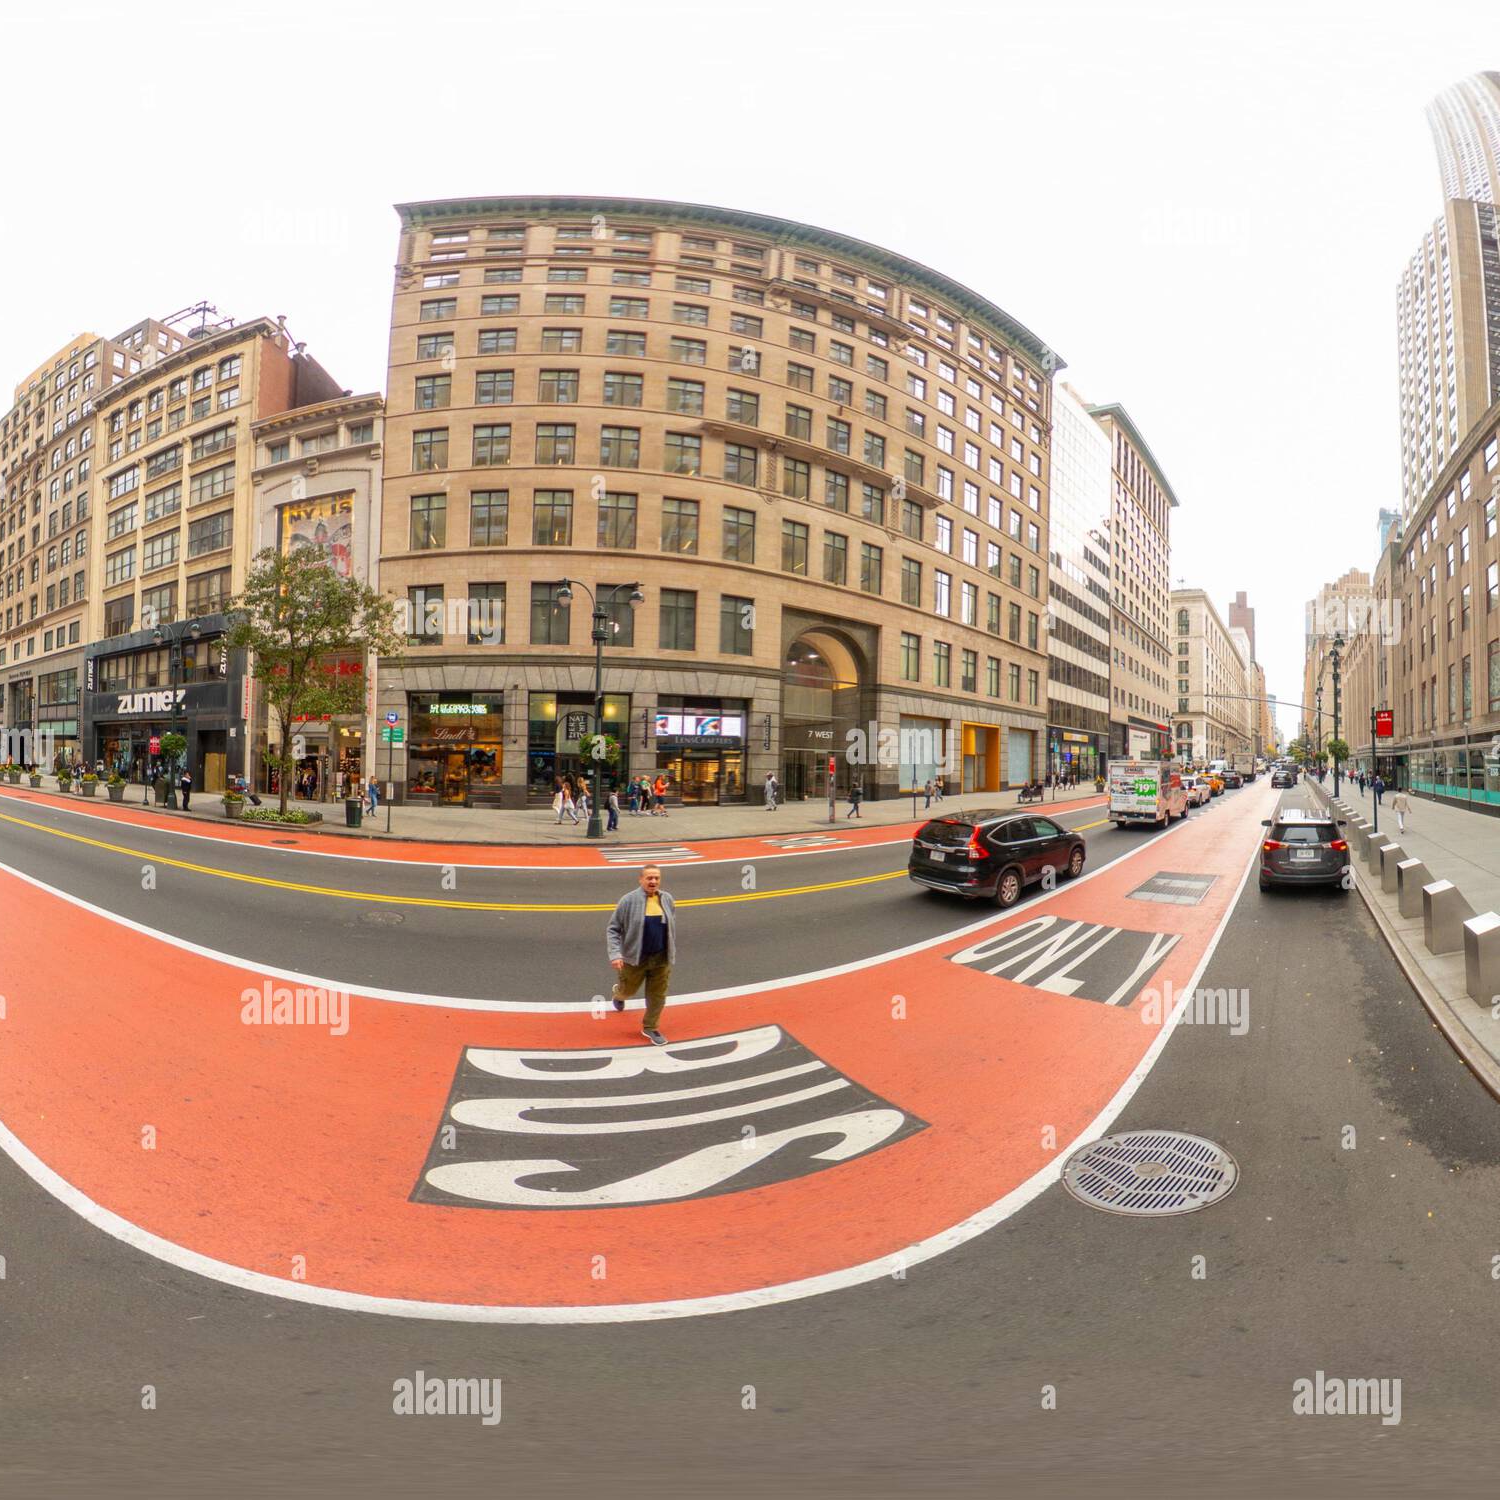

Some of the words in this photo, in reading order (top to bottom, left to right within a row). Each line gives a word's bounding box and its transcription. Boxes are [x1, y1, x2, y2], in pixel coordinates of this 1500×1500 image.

[434, 727, 467, 740] Lindt
[807, 730, 813, 738] 7
[814, 731, 834, 739] WEST
[951, 915, 1183, 1005] ONLY
[425, 1024, 905, 1206] BUS
